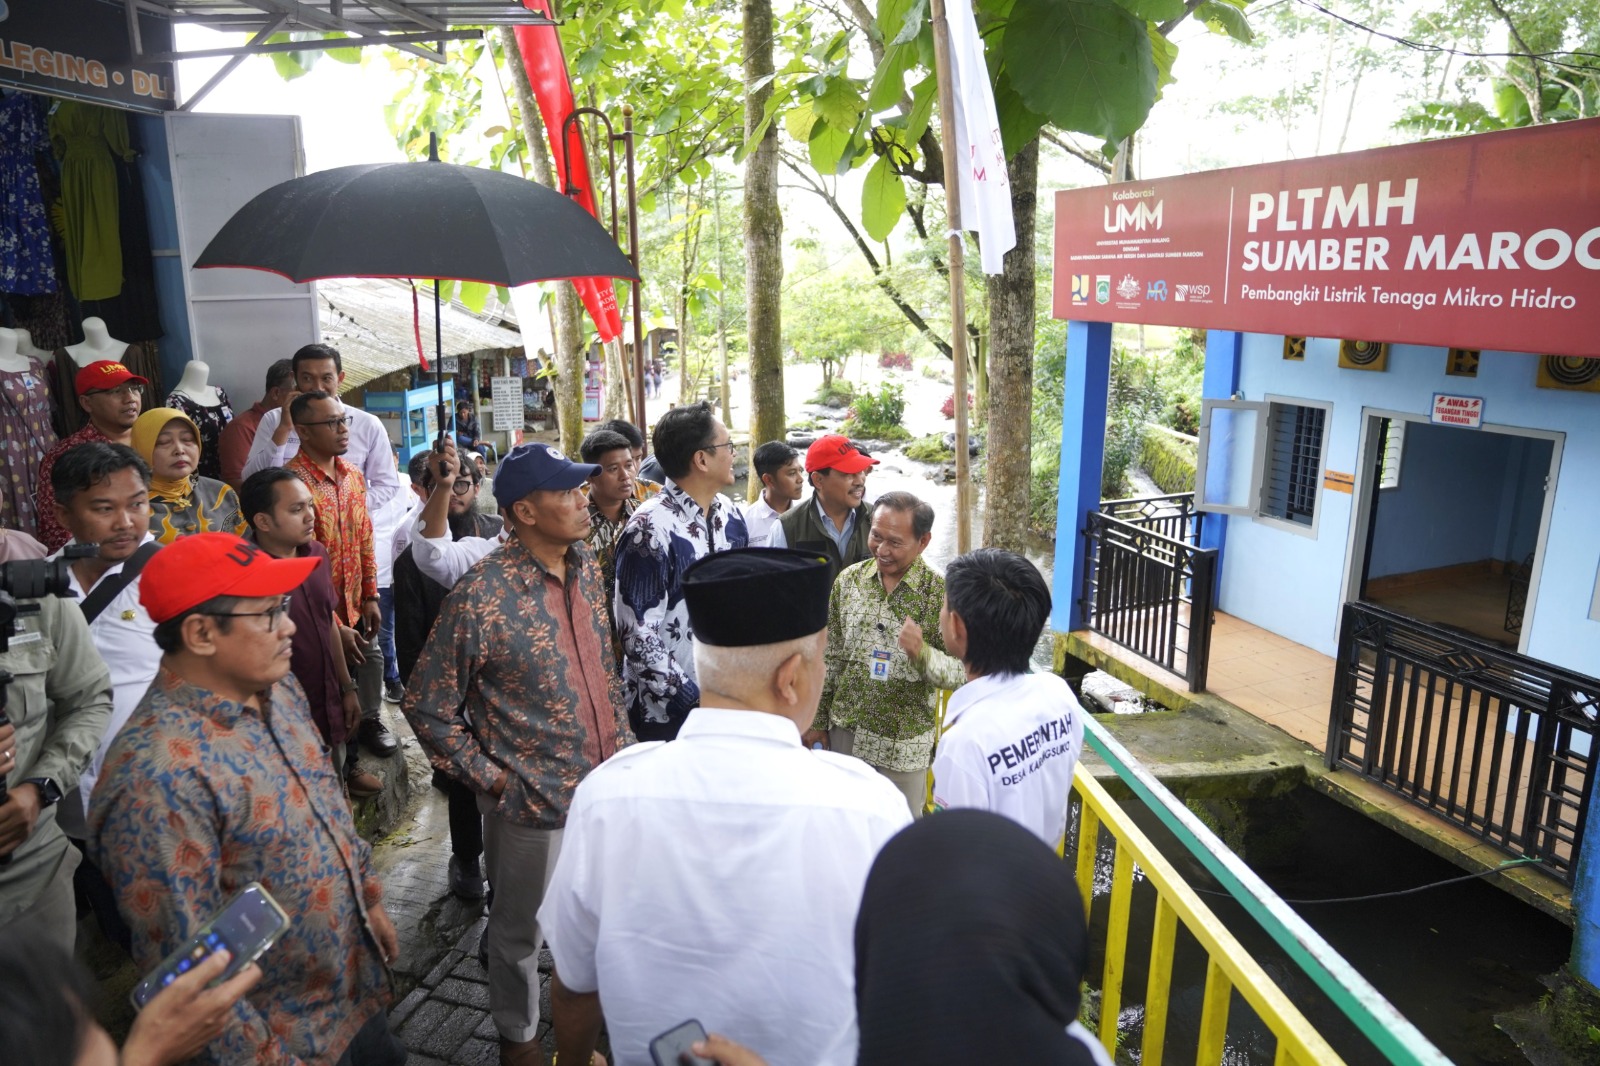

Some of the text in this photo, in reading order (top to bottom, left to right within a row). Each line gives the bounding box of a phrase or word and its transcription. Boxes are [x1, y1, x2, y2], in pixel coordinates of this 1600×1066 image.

[1112, 187, 1155, 200] Kolaborasi
[1248, 178, 1419, 233] PLTMH
[1104, 199, 1164, 233] UMM
[1241, 236, 1390, 272] SUMBER
[1241, 284, 1576, 310] Pembangkit Listrik Tenaga Mikro Hidro
[1435, 406, 1480, 418] TEGANGAN TINGGI
[1447, 398, 1470, 408] AWAS
